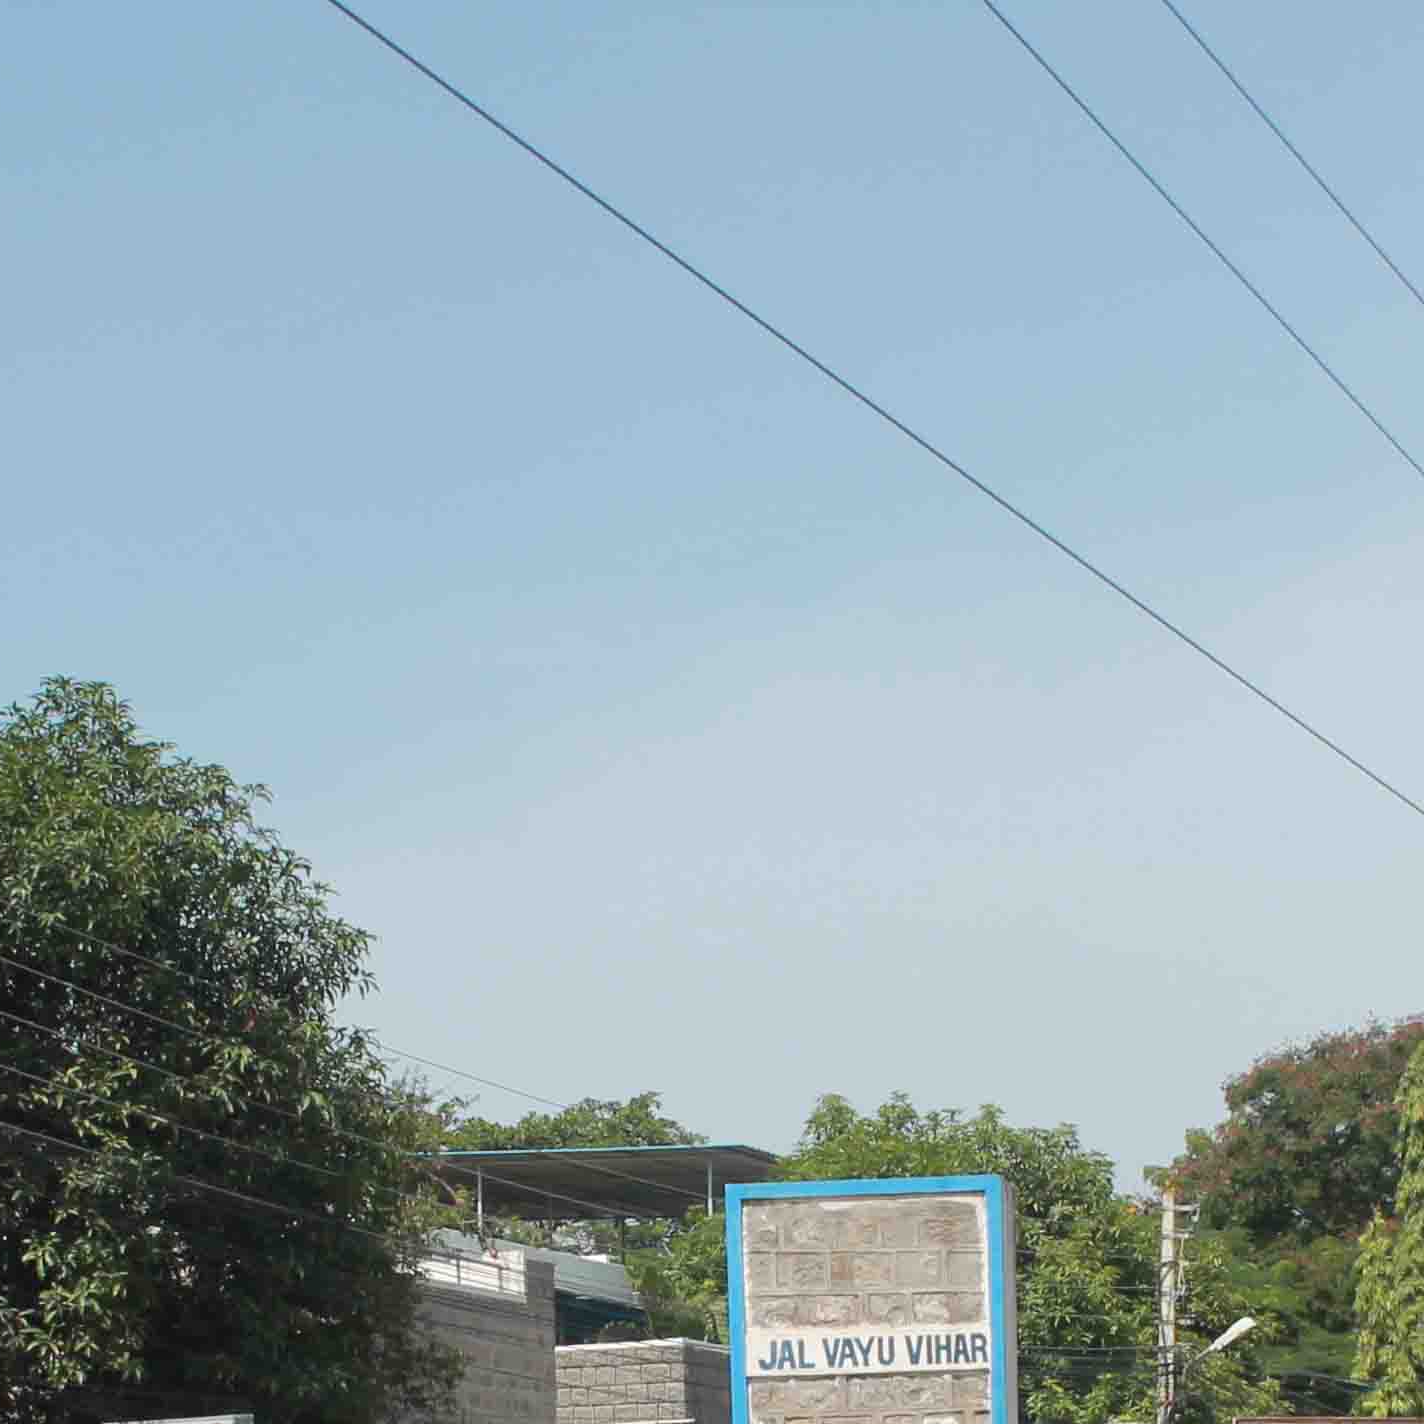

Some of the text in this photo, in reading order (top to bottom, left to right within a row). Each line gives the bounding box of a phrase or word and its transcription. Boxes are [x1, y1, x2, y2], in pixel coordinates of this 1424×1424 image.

[758, 1333, 988, 1370] JAL VAYU VIHAR
